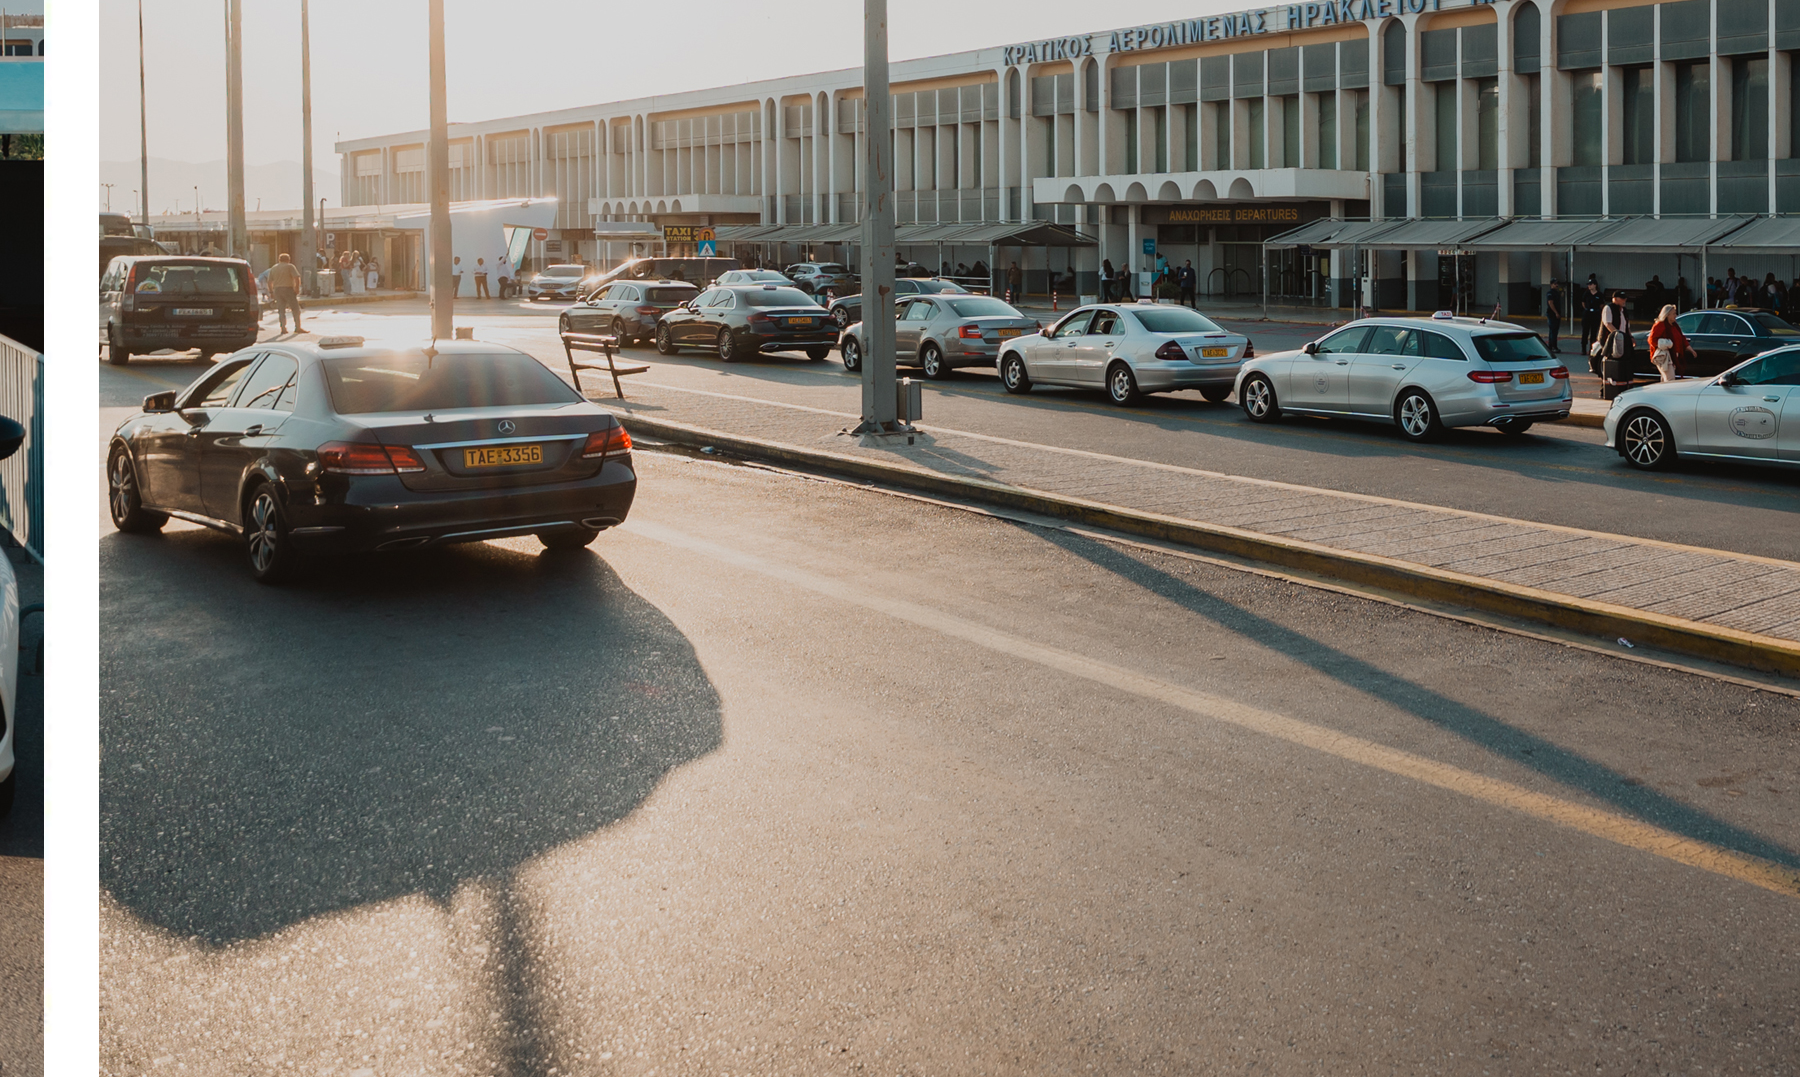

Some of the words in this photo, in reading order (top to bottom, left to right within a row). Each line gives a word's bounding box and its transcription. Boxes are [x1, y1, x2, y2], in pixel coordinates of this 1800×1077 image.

[1004, 35, 1093, 66] ΚΡΑΤΙΚΟΣ
[1109, 10, 1267, 53] ΑΕΡΟΛΙΜΕΝΑΣ
[1169, 209, 1231, 221] ΑΝΑΧΩΡΗΣΕΙΣ
[1235, 209, 1298, 221] DEPARTURES
[665, 227, 691, 235] TAXI
